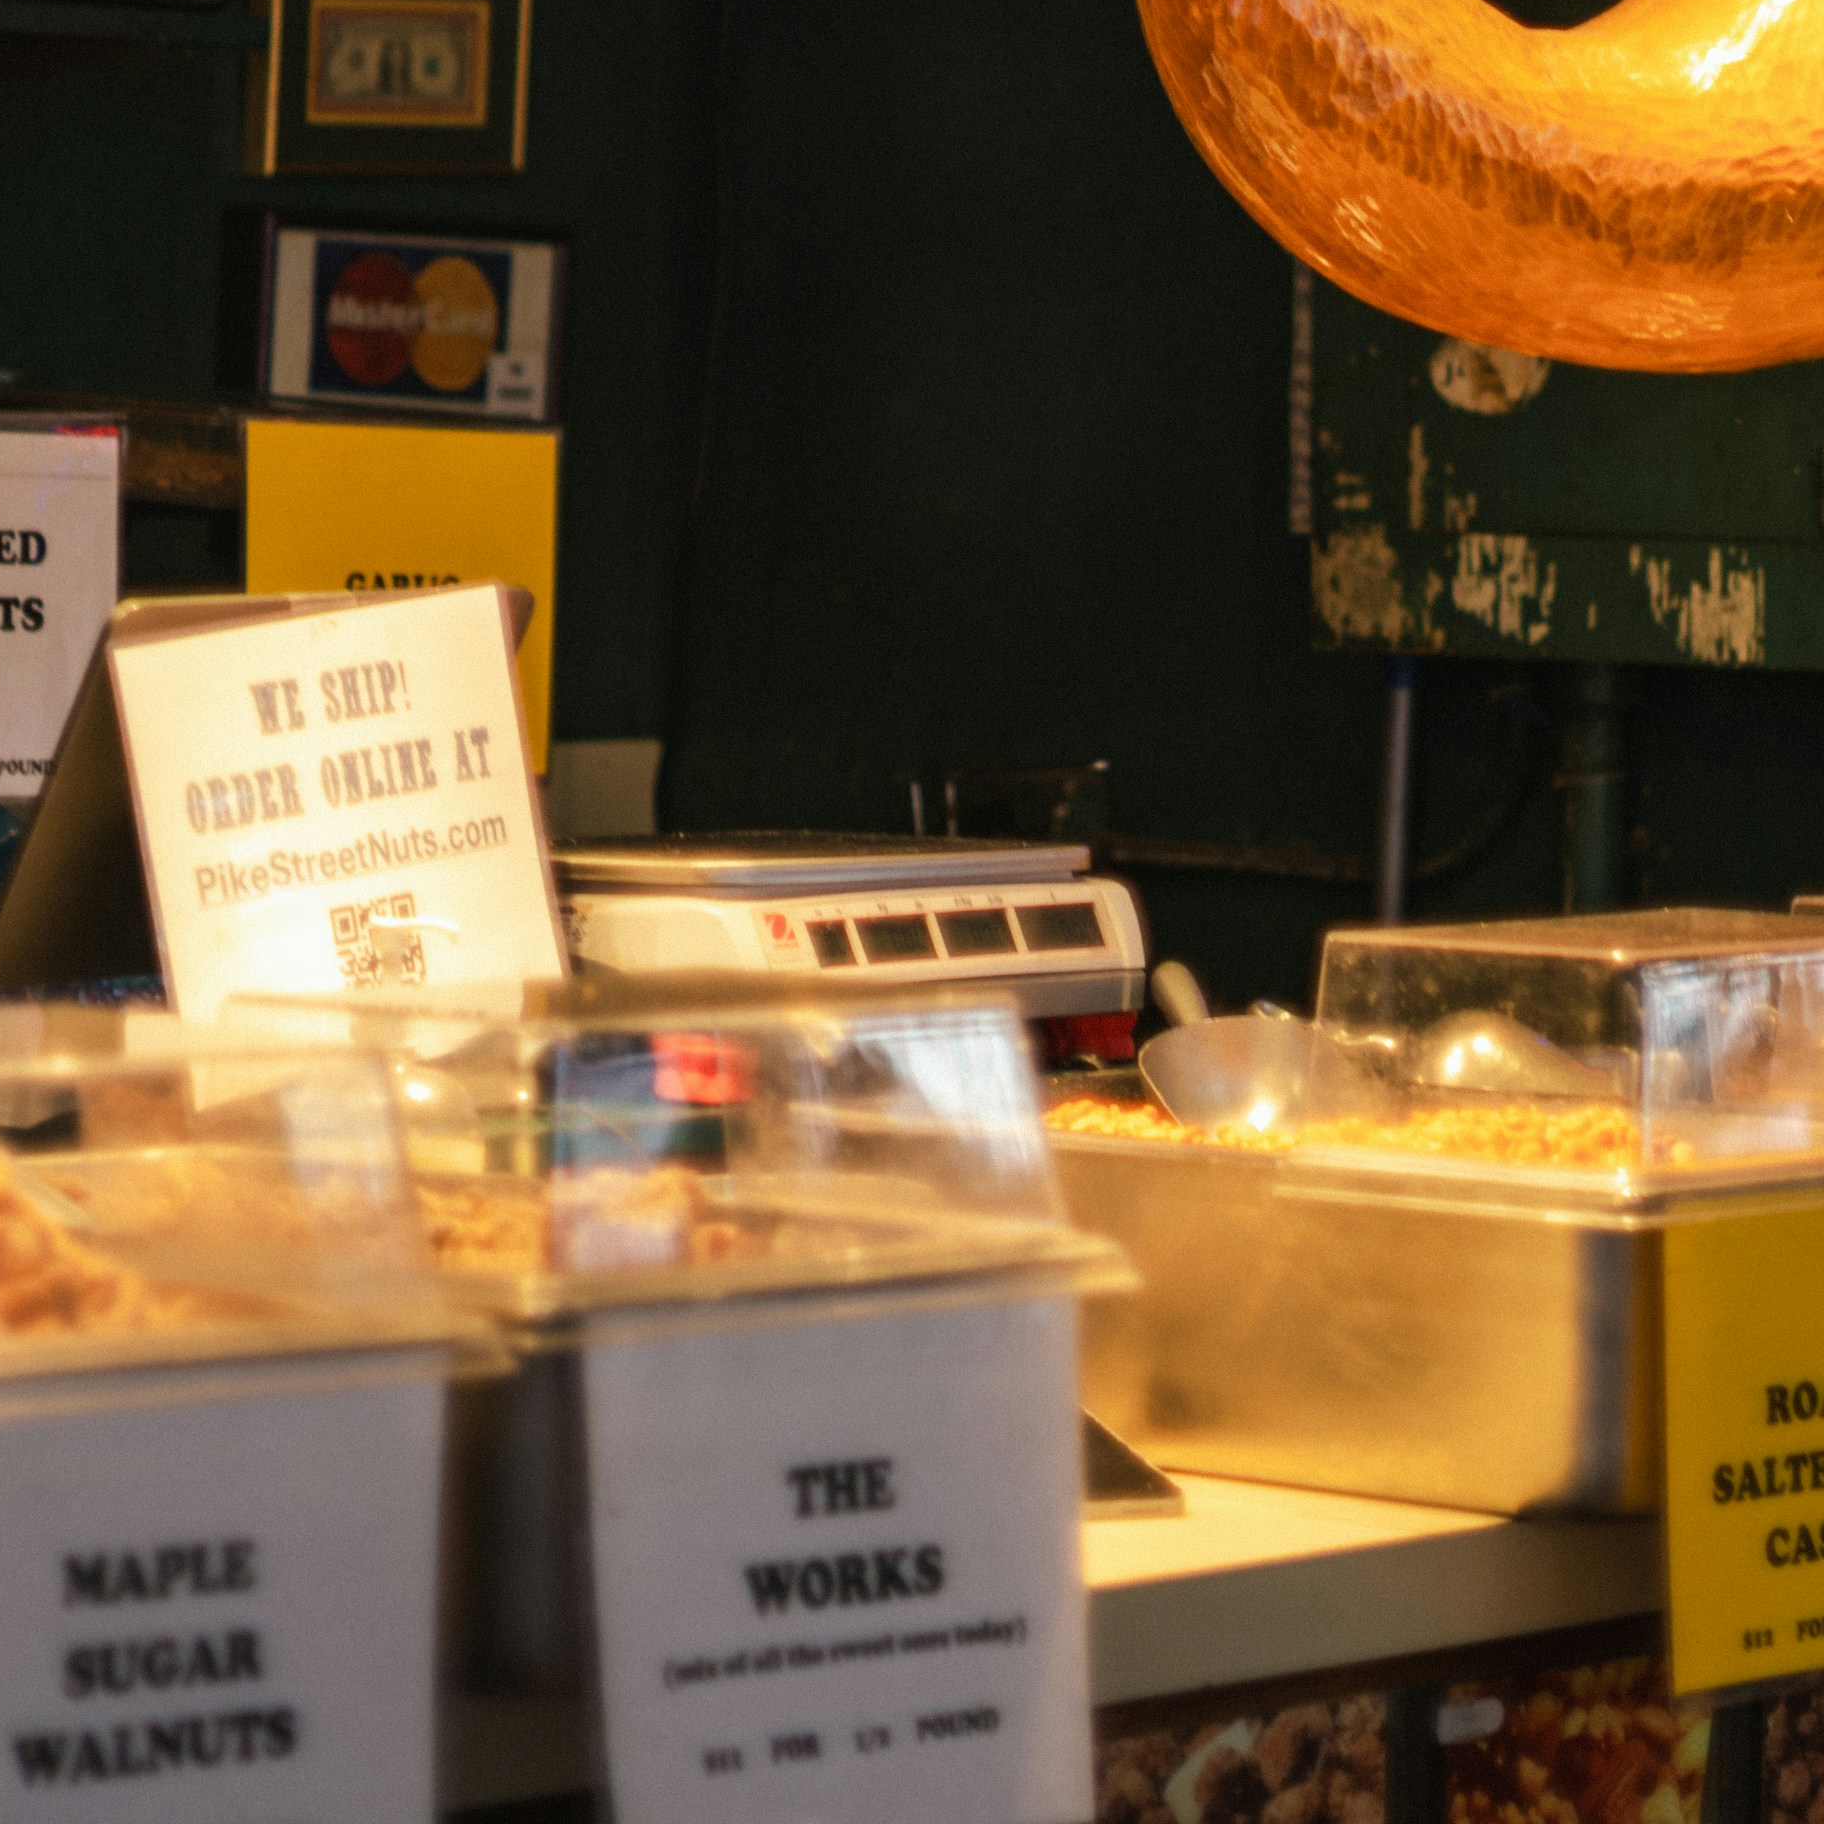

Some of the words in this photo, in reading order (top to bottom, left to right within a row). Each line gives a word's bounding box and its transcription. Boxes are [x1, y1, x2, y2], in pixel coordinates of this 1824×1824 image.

[248, 677, 305, 736] WE
[321, 659, 414, 723] SHIP!
[184, 763, 305, 835] ORDER
[320, 737, 438, 811] ONLINE
[453, 727, 492, 781] AT
[193, 813, 509, 909] PikeStreetNuts.com
[787, 1457, 895, 1520] THE
[63, 1537, 256, 1608] MAPLE
[744, 1543, 945, 1617] WORKS
[64, 1628, 263, 1699] SUGAR
[1743, 1629, 1774, 1652] $12
[14, 1705, 297, 1788] WALNUTS
